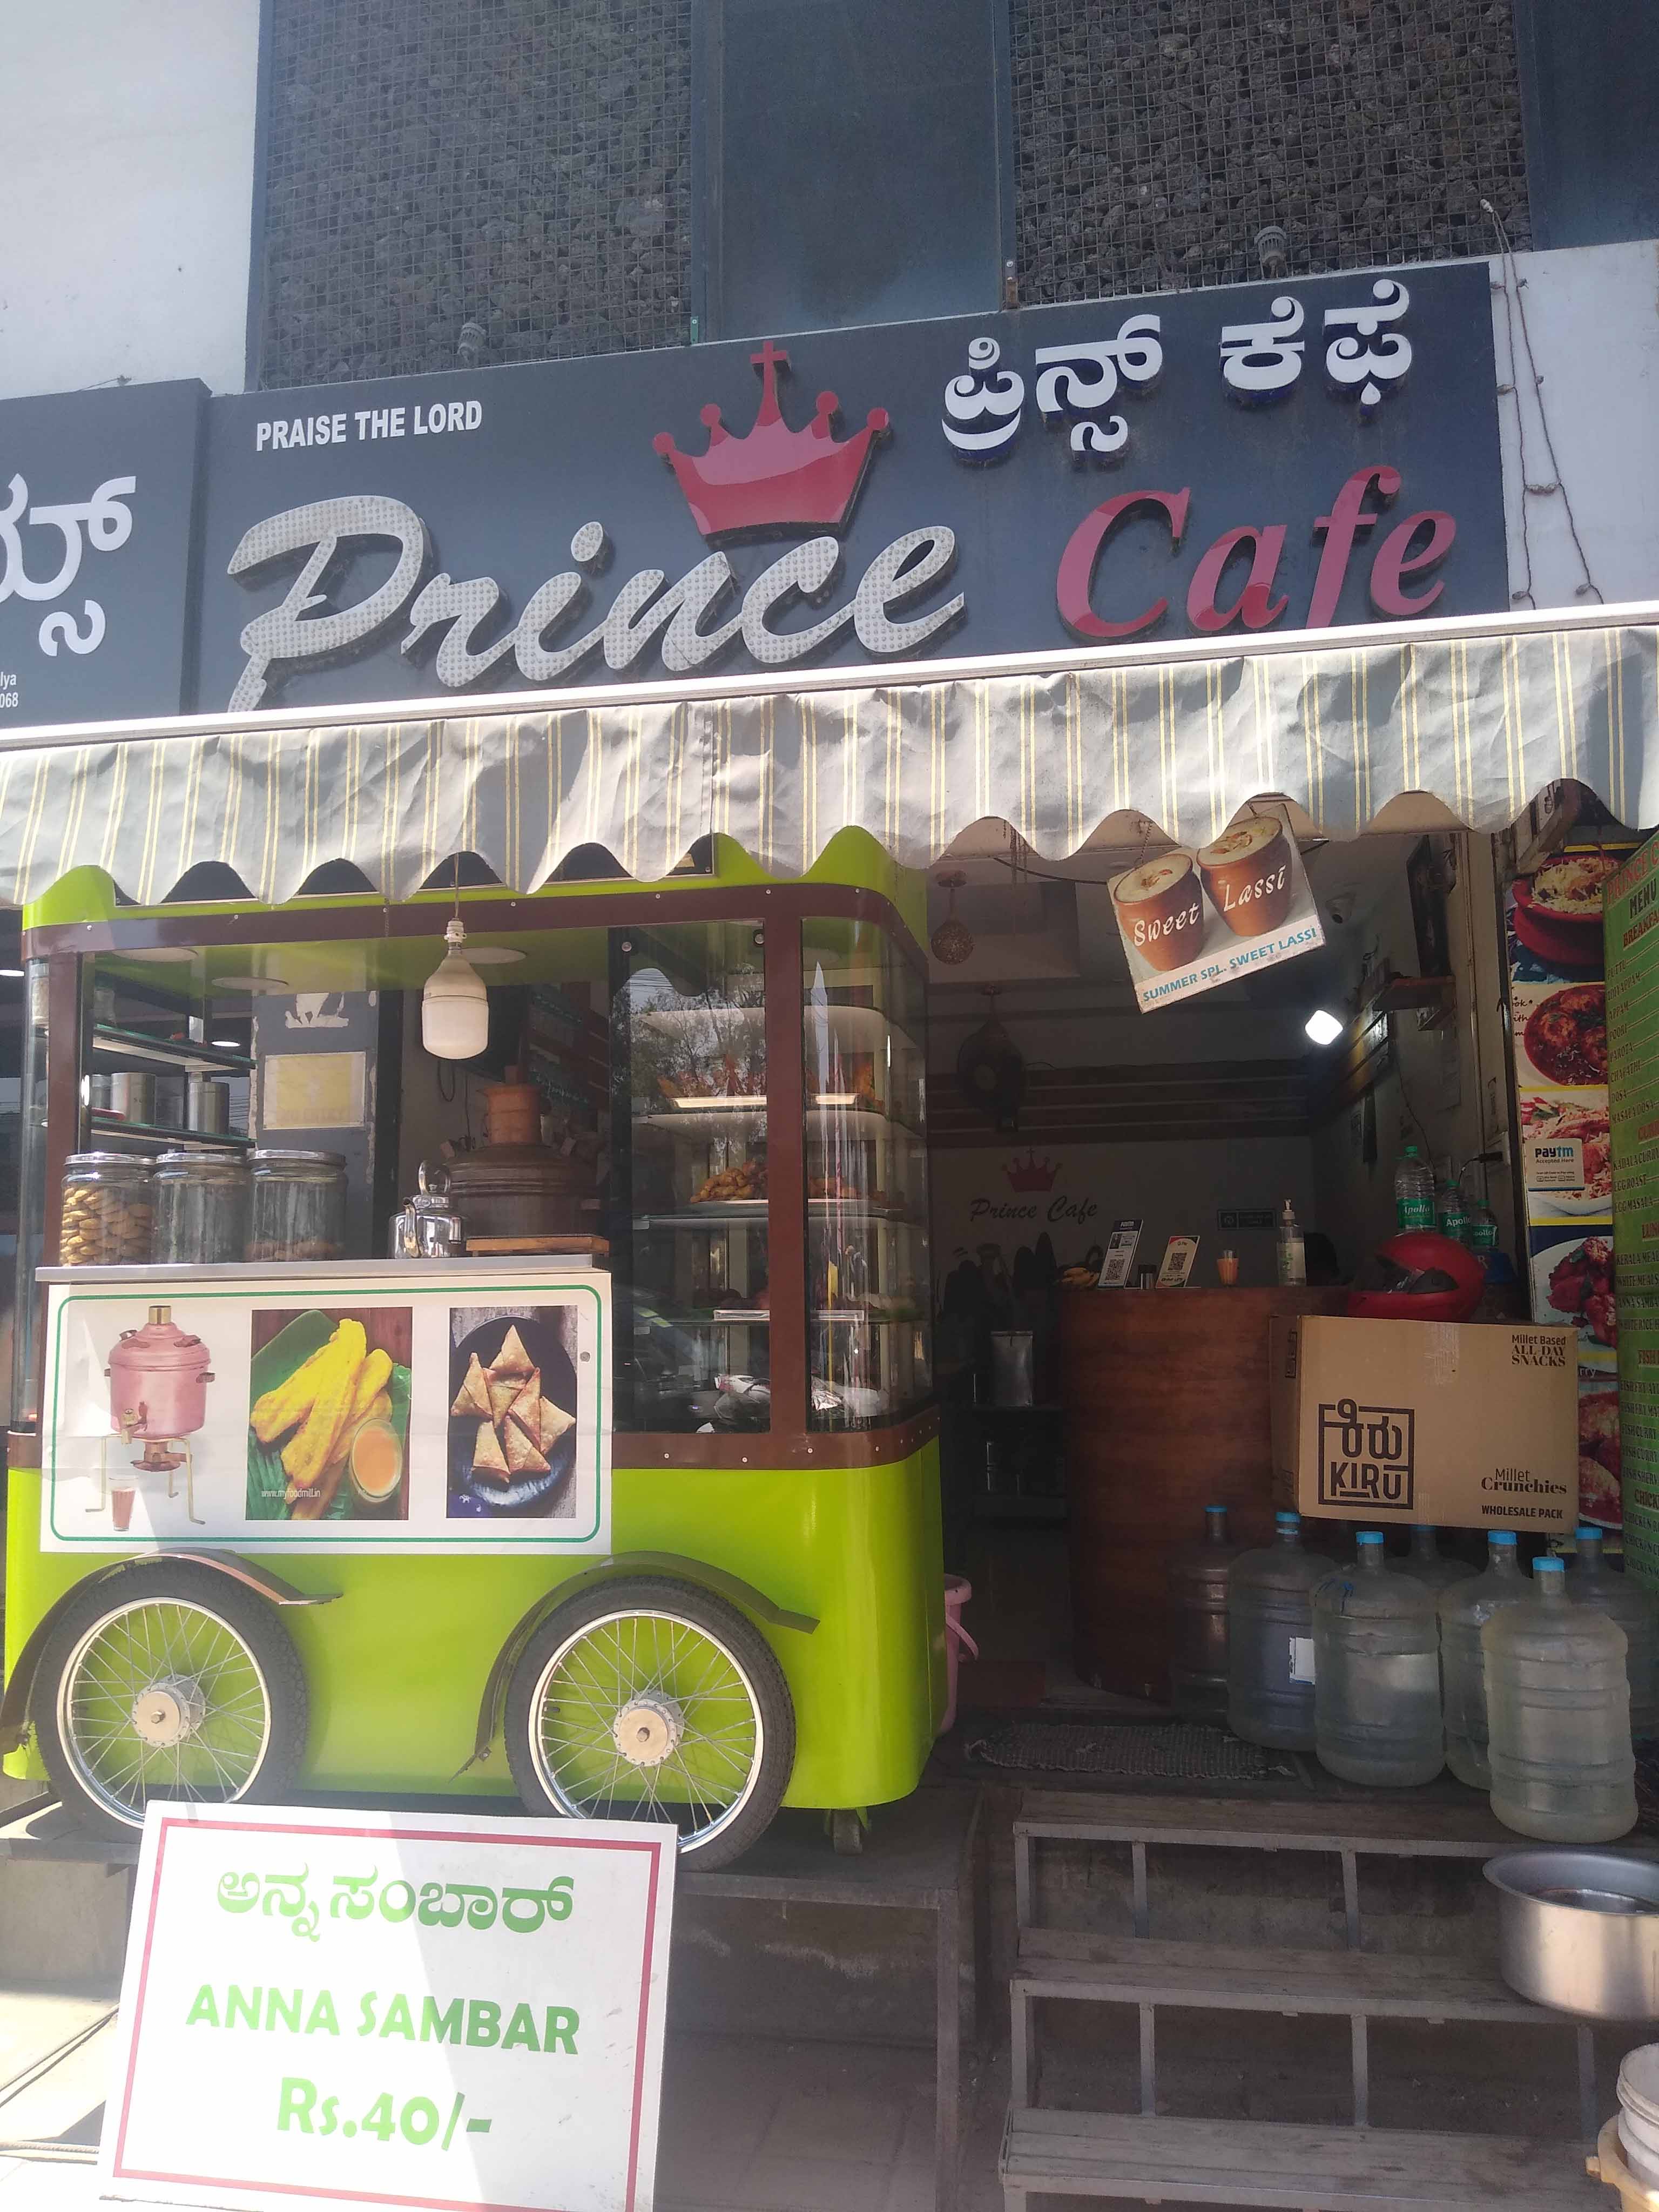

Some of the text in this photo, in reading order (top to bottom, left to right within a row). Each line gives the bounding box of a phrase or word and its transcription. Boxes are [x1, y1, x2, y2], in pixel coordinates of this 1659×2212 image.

[255, 400, 482, 451] PRAISE THE LORD
[227, 464, 1457, 713] Prince Cafe
[1134, 865, 1286, 947] Sweet Lassi
[1629, 878, 1656, 919] MENU
[1142, 973, 1198, 1002] SUMMER
[1229, 943, 1275, 969] SWEET
[1278, 927, 1317, 950] LASSI
[970, 1195, 1097, 1225] Prince Cafe
[1512, 1334, 1537, 1344] Millet
[1540, 1335, 1566, 1345] Based
[1512, 1354, 1566, 1367] SNACKS
[1330, 1461, 1401, 1500] KIRU
[1481, 1477, 1567, 1494] Crunchies
[1495, 1468, 1530, 1482] Millet
[1481, 1505, 1563, 1519] WHOLESALE PACK
[185, 1984, 581, 2055] ANNA SAMBAR
[276, 2076, 493, 2152] Rs.40/-
